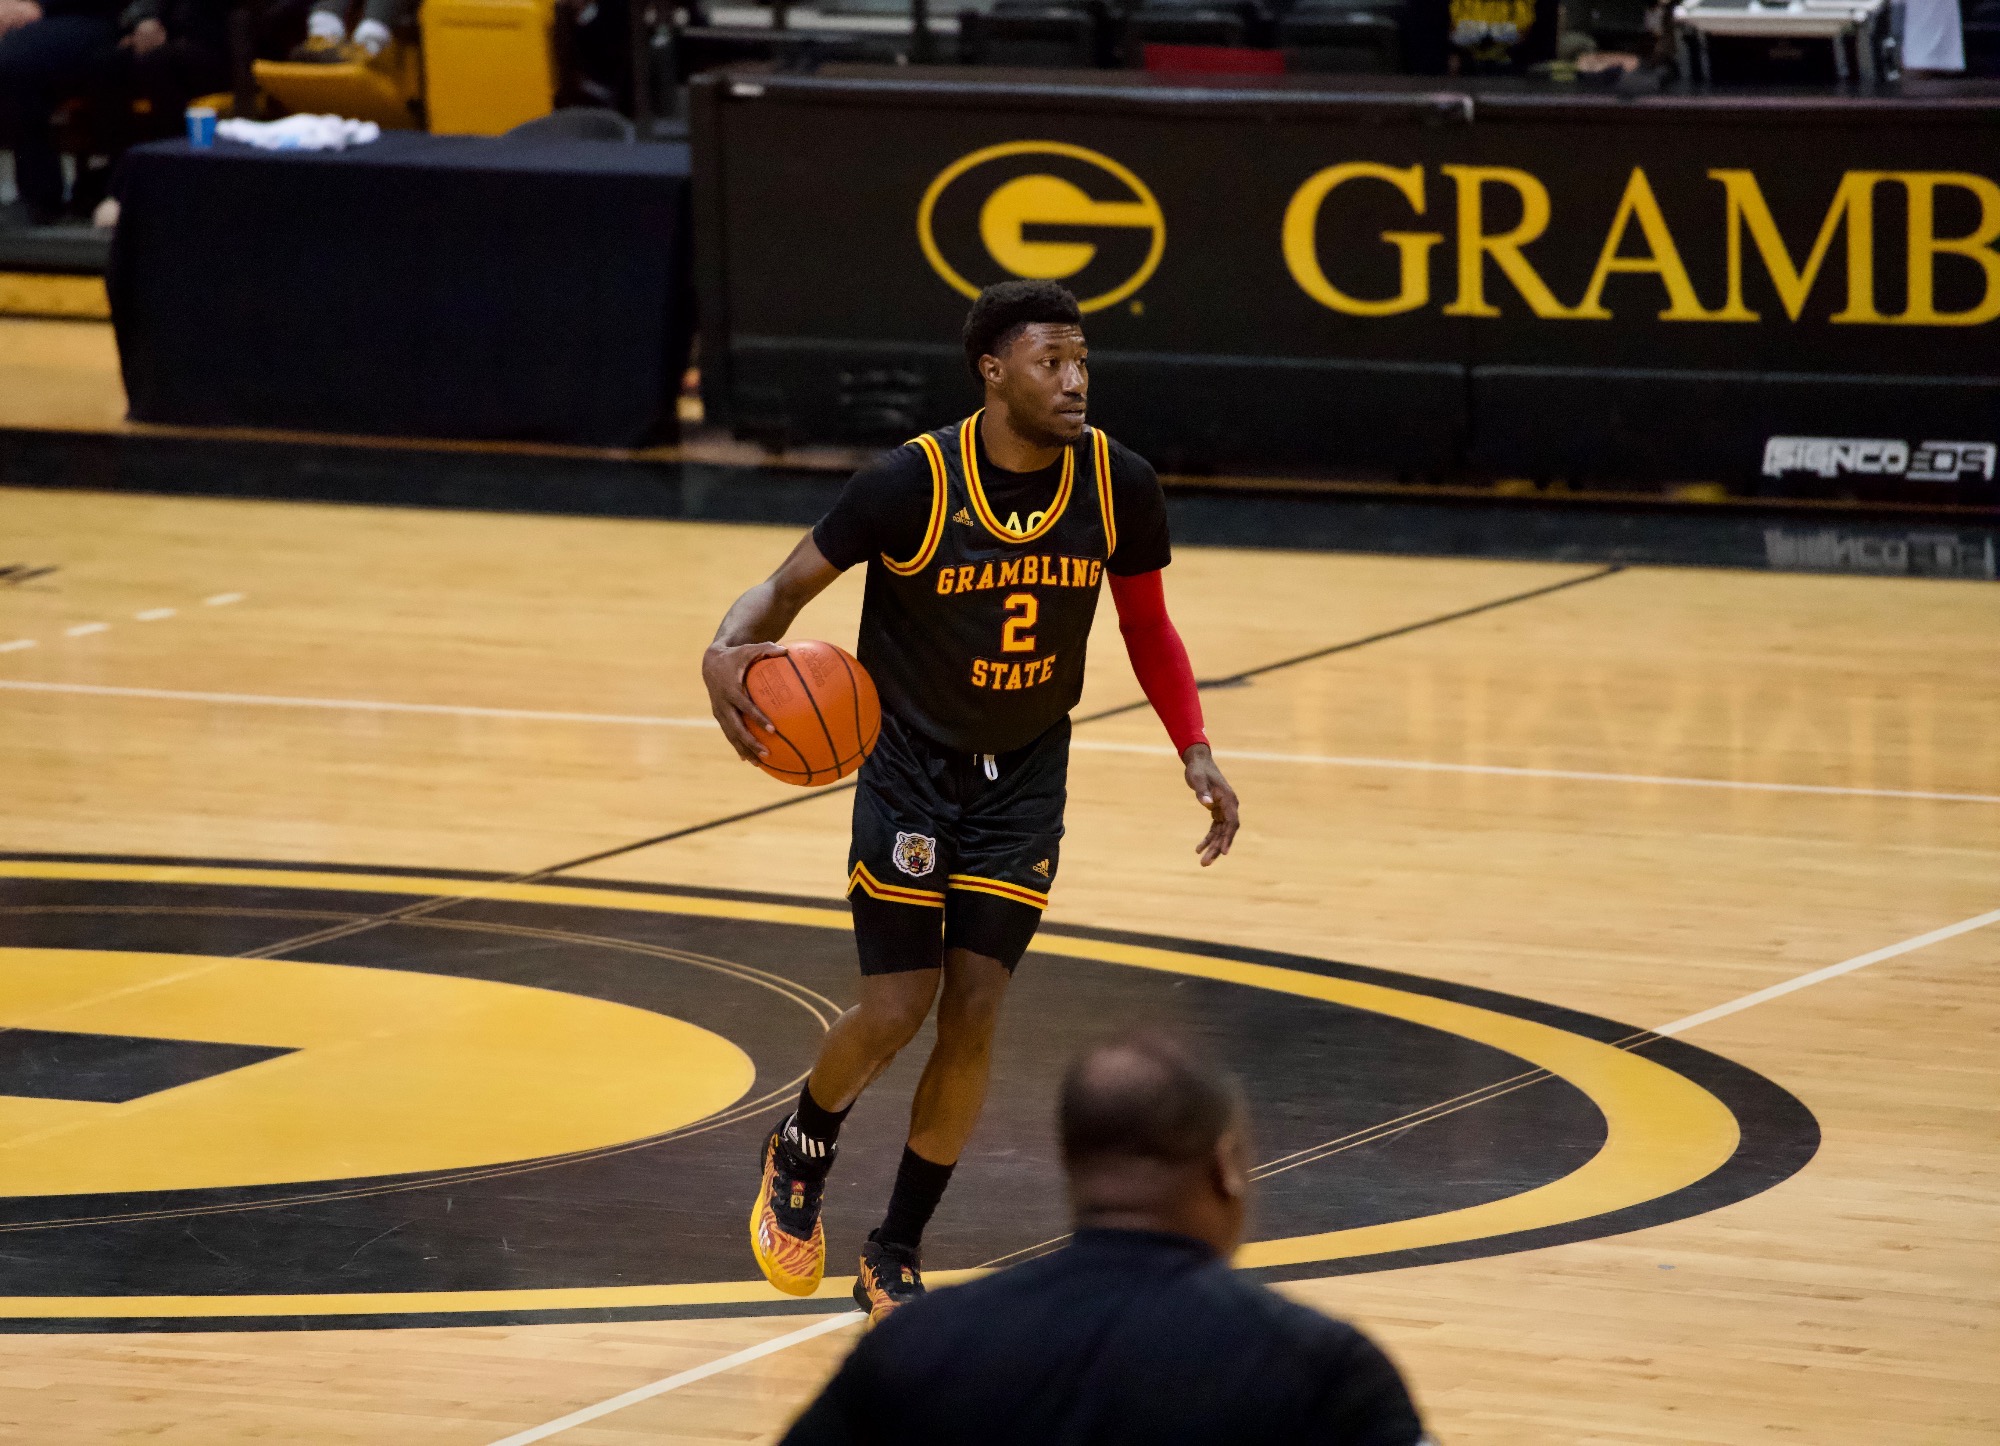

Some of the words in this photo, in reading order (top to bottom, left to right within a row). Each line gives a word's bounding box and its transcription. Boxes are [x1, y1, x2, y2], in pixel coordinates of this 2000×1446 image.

[1282, 162, 2000, 326] GRAMB
[937, 556, 1101, 595] GRAMBLING
[1001, 592, 1038, 652] 2
[971, 655, 1056, 690] STATE
